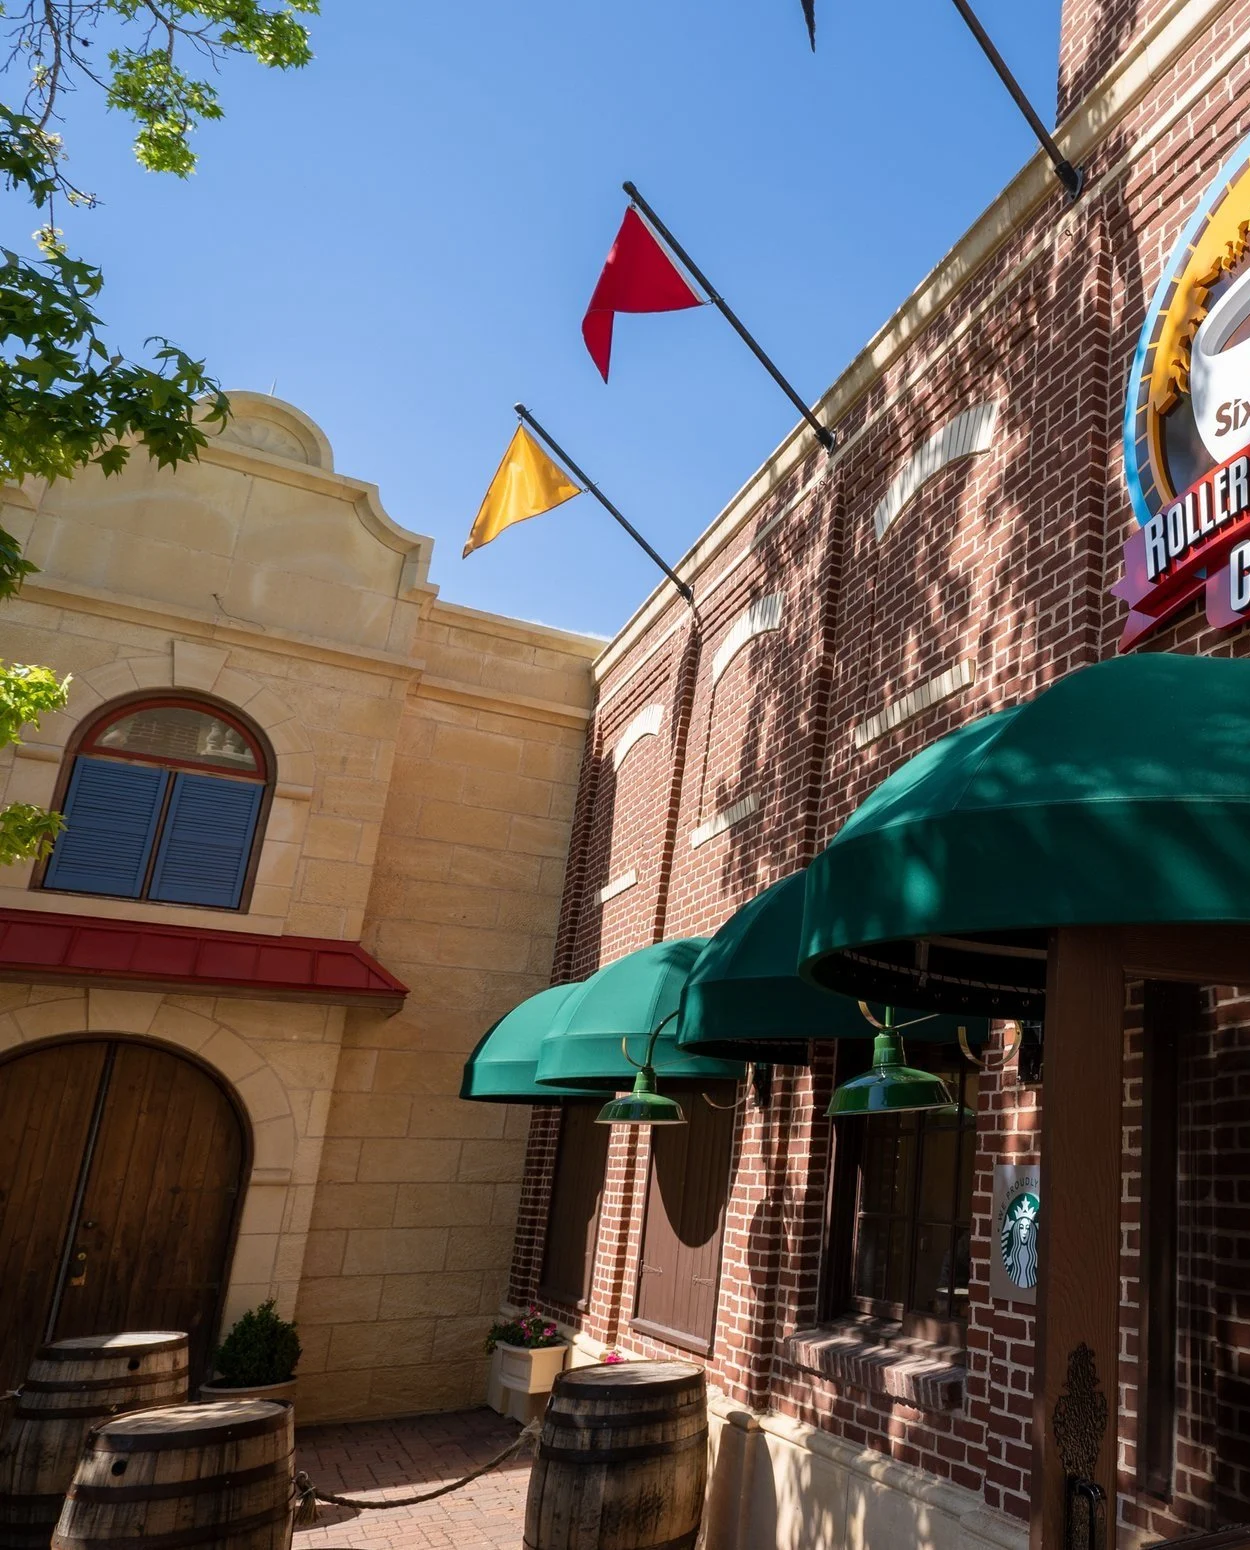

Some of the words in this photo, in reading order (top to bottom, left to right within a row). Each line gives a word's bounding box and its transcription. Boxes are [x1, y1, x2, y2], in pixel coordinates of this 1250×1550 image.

[1144, 455, 1250, 582] ROLLER
[998, 1201, 1007, 1221] WE
[1006, 1177, 1039, 1200] PROUDLY
